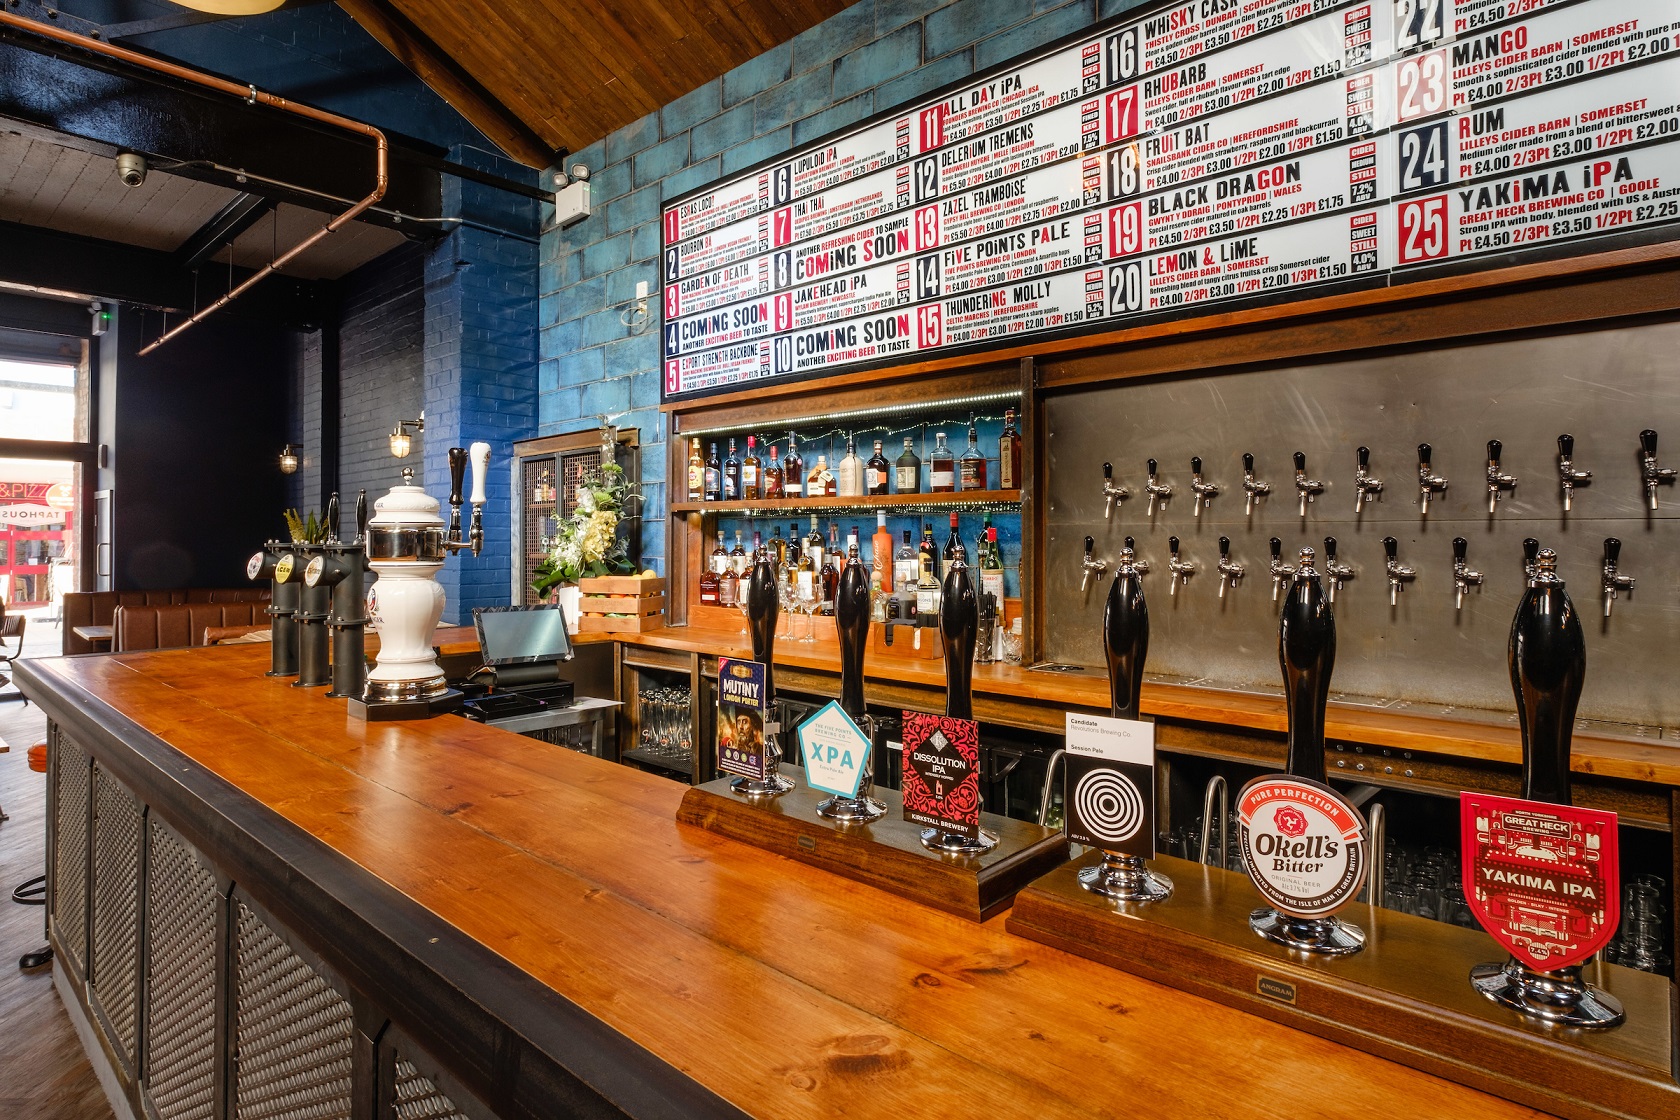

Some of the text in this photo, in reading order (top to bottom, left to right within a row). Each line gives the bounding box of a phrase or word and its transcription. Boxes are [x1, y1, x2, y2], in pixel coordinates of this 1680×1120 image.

[1145, 9, 1237, 50] THISTLY CROSS DUNBAR
[1109, 30, 1134, 81] 16
[1452, 25, 1527, 68] MANGO
[1453, 24, 1668, 89] Smooth & sophisticated cider blended with pure
[1144, 62, 1206, 99] RHUBARB
[1399, 53, 1444, 118] 23
[942, 96, 966, 118] ALL
[971, 83, 996, 107] DAY
[924, 108, 938, 148] 11
[988, 122, 1033, 152] TREMENS
[1185, 122, 1209, 147] BAT
[1458, 107, 1504, 139] RUM
[1459, 98, 1647, 151] LILLEYS CIDER BARN SOMERSET
[1402, 126, 1445, 189] 24
[1350, 165, 1375, 180] STILL
[1148, 161, 1300, 217] BLACK DRAGON
[1351, 181, 1373, 196] 7.2%
[1459, 177, 1659, 225] GREAT HECK BREWING CO GOOLE
[1148, 183, 1302, 227] GWYNT Y DDRAIG PONTYPRIDD WALES
[669, 212, 674, 241] 1
[795, 216, 908, 258] ANOTHER REFRESHING CIDER TO SAMPLE
[1031, 221, 1070, 246] PALE
[1112, 205, 1138, 254] 19
[1351, 226, 1375, 239] SWEET
[1403, 198, 1442, 259] 25
[1459, 200, 1680, 252] Pt £4.50 2/3Pt £3.50 1/2Pt £2.25
[863, 228, 909, 262] SOON
[1352, 239, 1375, 251] STILL
[1352, 252, 1375, 265] 4.0%
[1148, 249, 1197, 277] LEMON
[1203, 246, 1215, 266] &
[681, 263, 748, 294] GARDEN OF DEATH
[794, 279, 846, 304] JAKEHEAD
[1013, 280, 1050, 303] MOLLY
[1110, 263, 1140, 313] 20
[733, 301, 767, 328] SOON
[778, 295, 787, 329] 9
[919, 305, 939, 346] 15
[946, 301, 1038, 325] CELTIC MARCHES HEREFORDSHIRE
[668, 324, 677, 353] 4
[863, 313, 909, 343] SOON
[729, 343, 758, 360] BACKBONE
[776, 337, 790, 372] 10
[797, 339, 910, 368] ANOTHER EXCITING BEER TO TASTE
[669, 361, 676, 391] 5
[723, 693, 758, 707] LONDON PORTER
[815, 728, 836, 737] BREWING
[835, 727, 851, 735] POINTS
[1070, 718, 1098, 726] Candidate
[1071, 724, 1099, 733] Revolutions
[1100, 728, 1121, 737] Brewing
[811, 742, 854, 770] XPA
[913, 752, 966, 770] DISSOLUTION
[1071, 744, 1091, 752] Session
[932, 764, 946, 774] IPA
[1250, 788, 1340, 817] PURE PERFECTION
[1531, 812, 1558, 820] YORKSHIRE
[911, 813, 969, 833] KIRKSTALL BREWERY
[1505, 816, 1568, 832] GREAT HECK
[1522, 826, 1550, 834] BREWING
[1243, 830, 1252, 860] SPECIALLY
[1249, 861, 1269, 889] IMPORTED
[1268, 887, 1285, 900] FROM
[1285, 897, 1297, 906] THE
[1321, 894, 1336, 904] MAN
[1333, 888, 1343, 896] TO
[1340, 872, 1353, 890] GREAT
[1271, 874, 1301, 885] ORIGINAL
[1272, 858, 1324, 873] Bitter
[1482, 867, 1596, 900] YAKIMA IPA
[1548, 906, 1569, 914] INTENSE
[1530, 947, 1548, 956] 7.4%
[1260, 982, 1292, 997] ANGRAM
